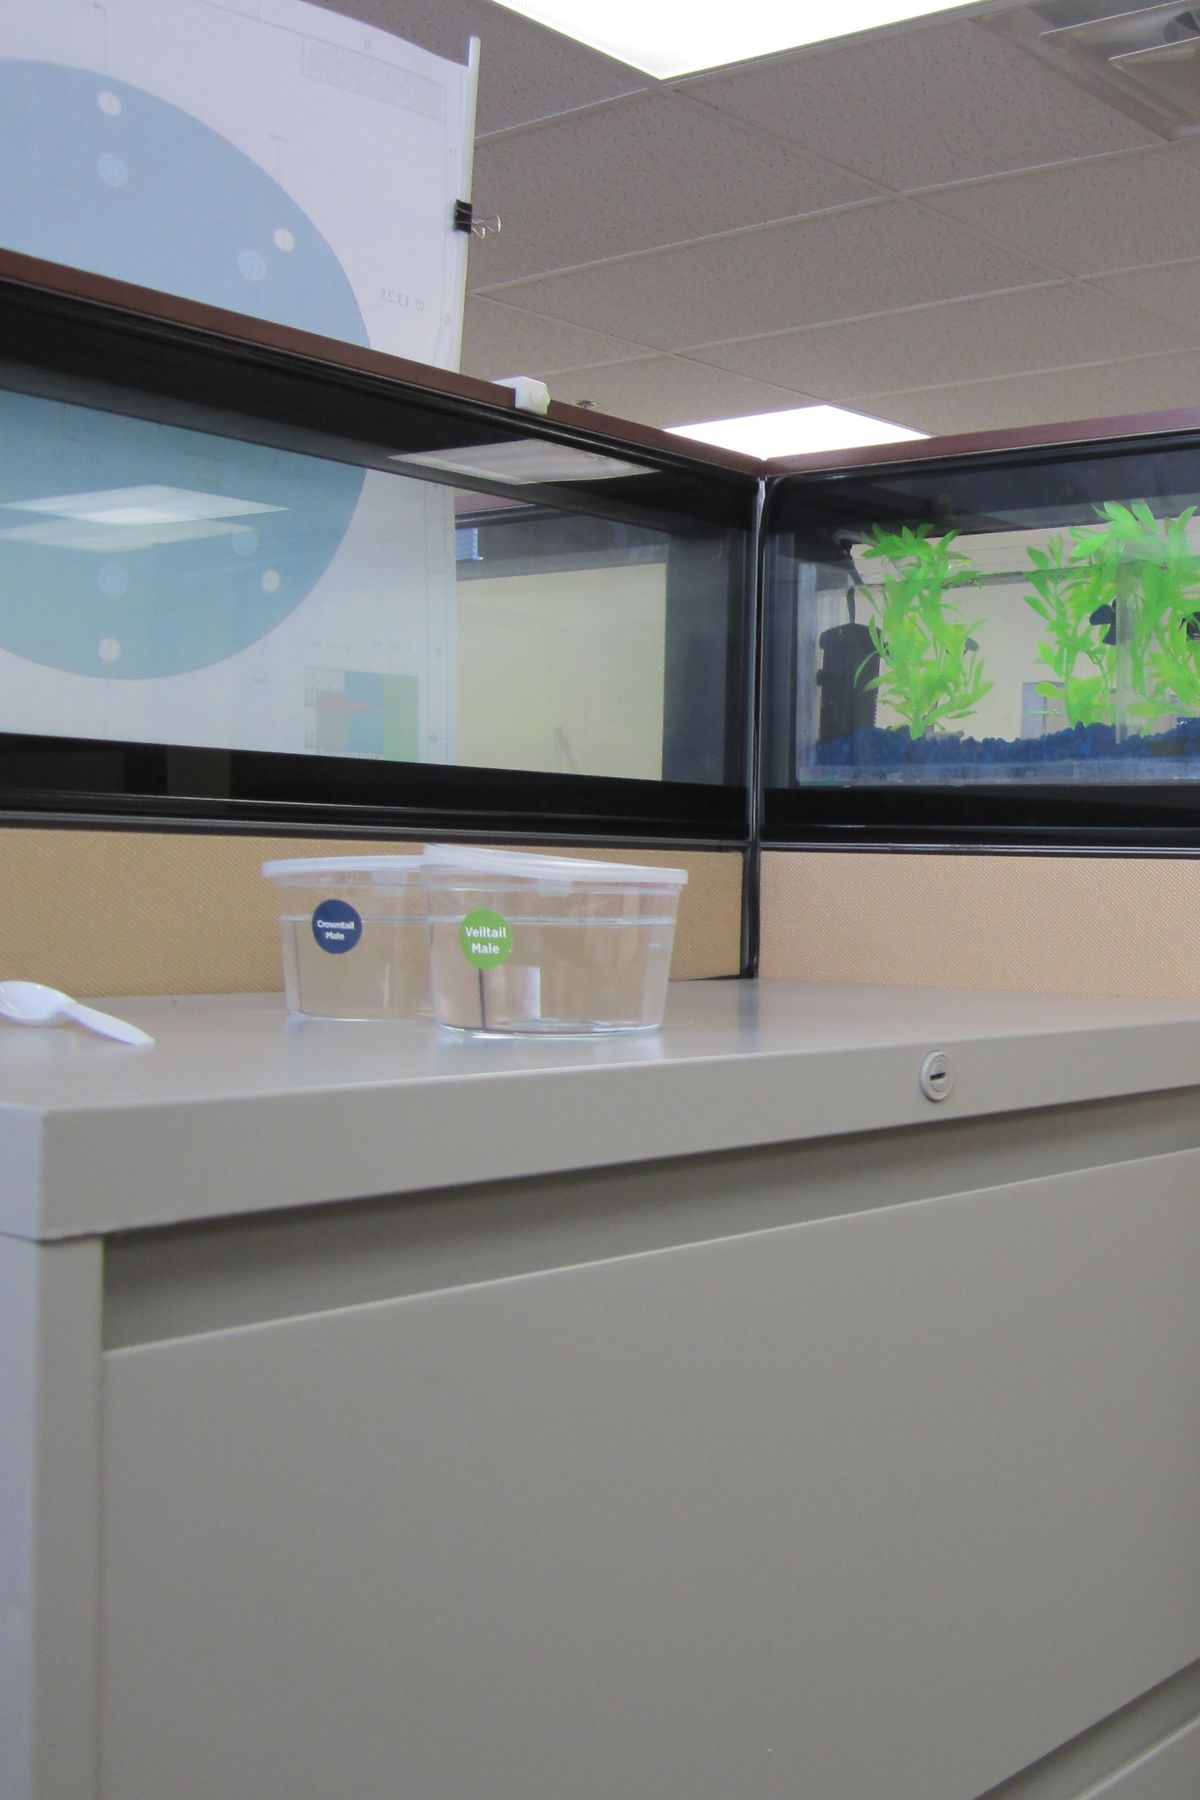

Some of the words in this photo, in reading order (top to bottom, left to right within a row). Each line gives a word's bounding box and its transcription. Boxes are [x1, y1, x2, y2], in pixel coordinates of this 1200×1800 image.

[317, 919, 355, 930] Crowntail
[325, 931, 345, 941] Male
[465, 926, 507, 938] Veiltail
[472, 943, 500, 954] Male
